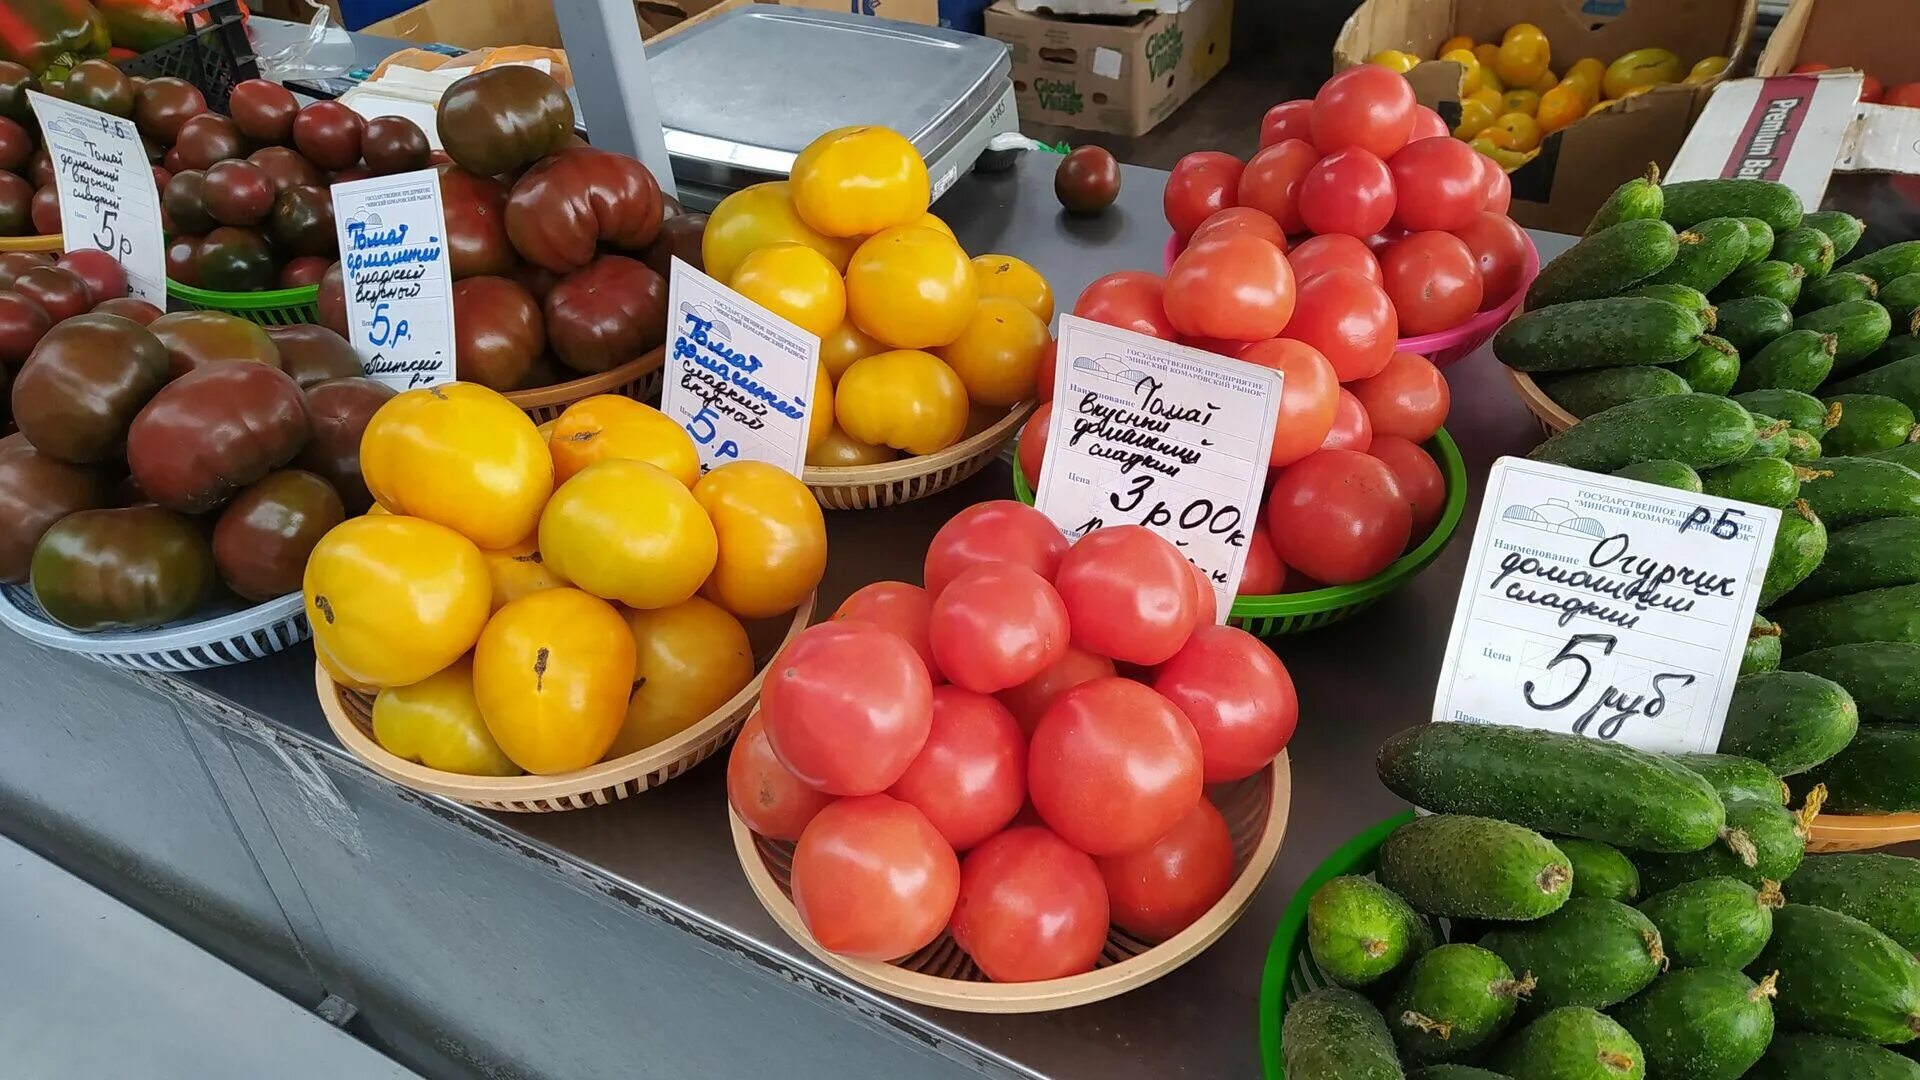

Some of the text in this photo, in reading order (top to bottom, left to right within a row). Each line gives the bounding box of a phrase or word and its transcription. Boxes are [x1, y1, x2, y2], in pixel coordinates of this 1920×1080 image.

[1033, 77, 1076, 94] Global
[1039, 93, 1084, 115] Village
[1748, 98, 1799, 156] Premium
[84, 141, 123, 166] Томат
[347, 221, 408, 250] Томат
[685, 313, 763, 374] Томат
[1126, 348, 1264, 391] ГОСУДАРСТВЕННОЕ ПРЕДПРИЯТИЕ
[1169, 368, 1230, 389] КОМАРОВСКИЙ
[683, 360, 768, 417] сладкий
[1134, 376, 1221, 426] Томат
[1068, 471, 1091, 486] Цена
[1578, 490, 1677, 517] ГОСУДАРСТВЕННОЕ
[1632, 511, 1711, 533] КОМАРОВКИЙ
[1494, 533, 1736, 600] Наименование Огурчик
[1505, 581, 1640, 628] сладкий
[1483, 647, 1511, 663] Цена
